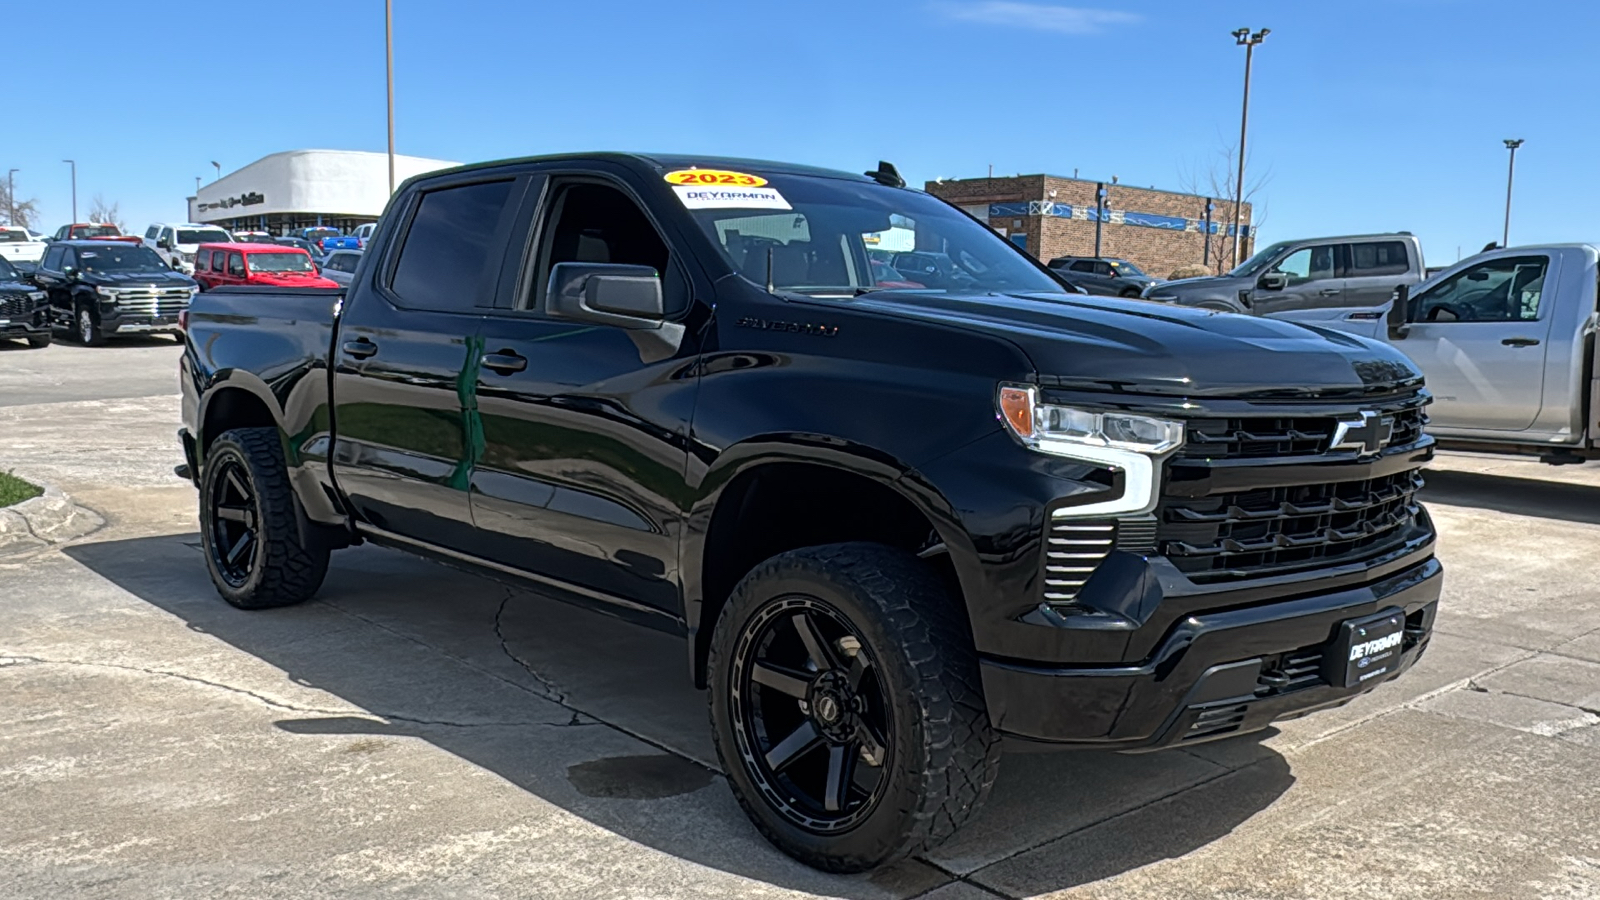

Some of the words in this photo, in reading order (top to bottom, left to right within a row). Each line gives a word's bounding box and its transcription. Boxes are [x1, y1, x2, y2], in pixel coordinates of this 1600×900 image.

[679, 174, 756, 185] 2023
[687, 192, 775, 200] DEYARMAN
[1350, 631, 1403, 661] DEYARMAN
